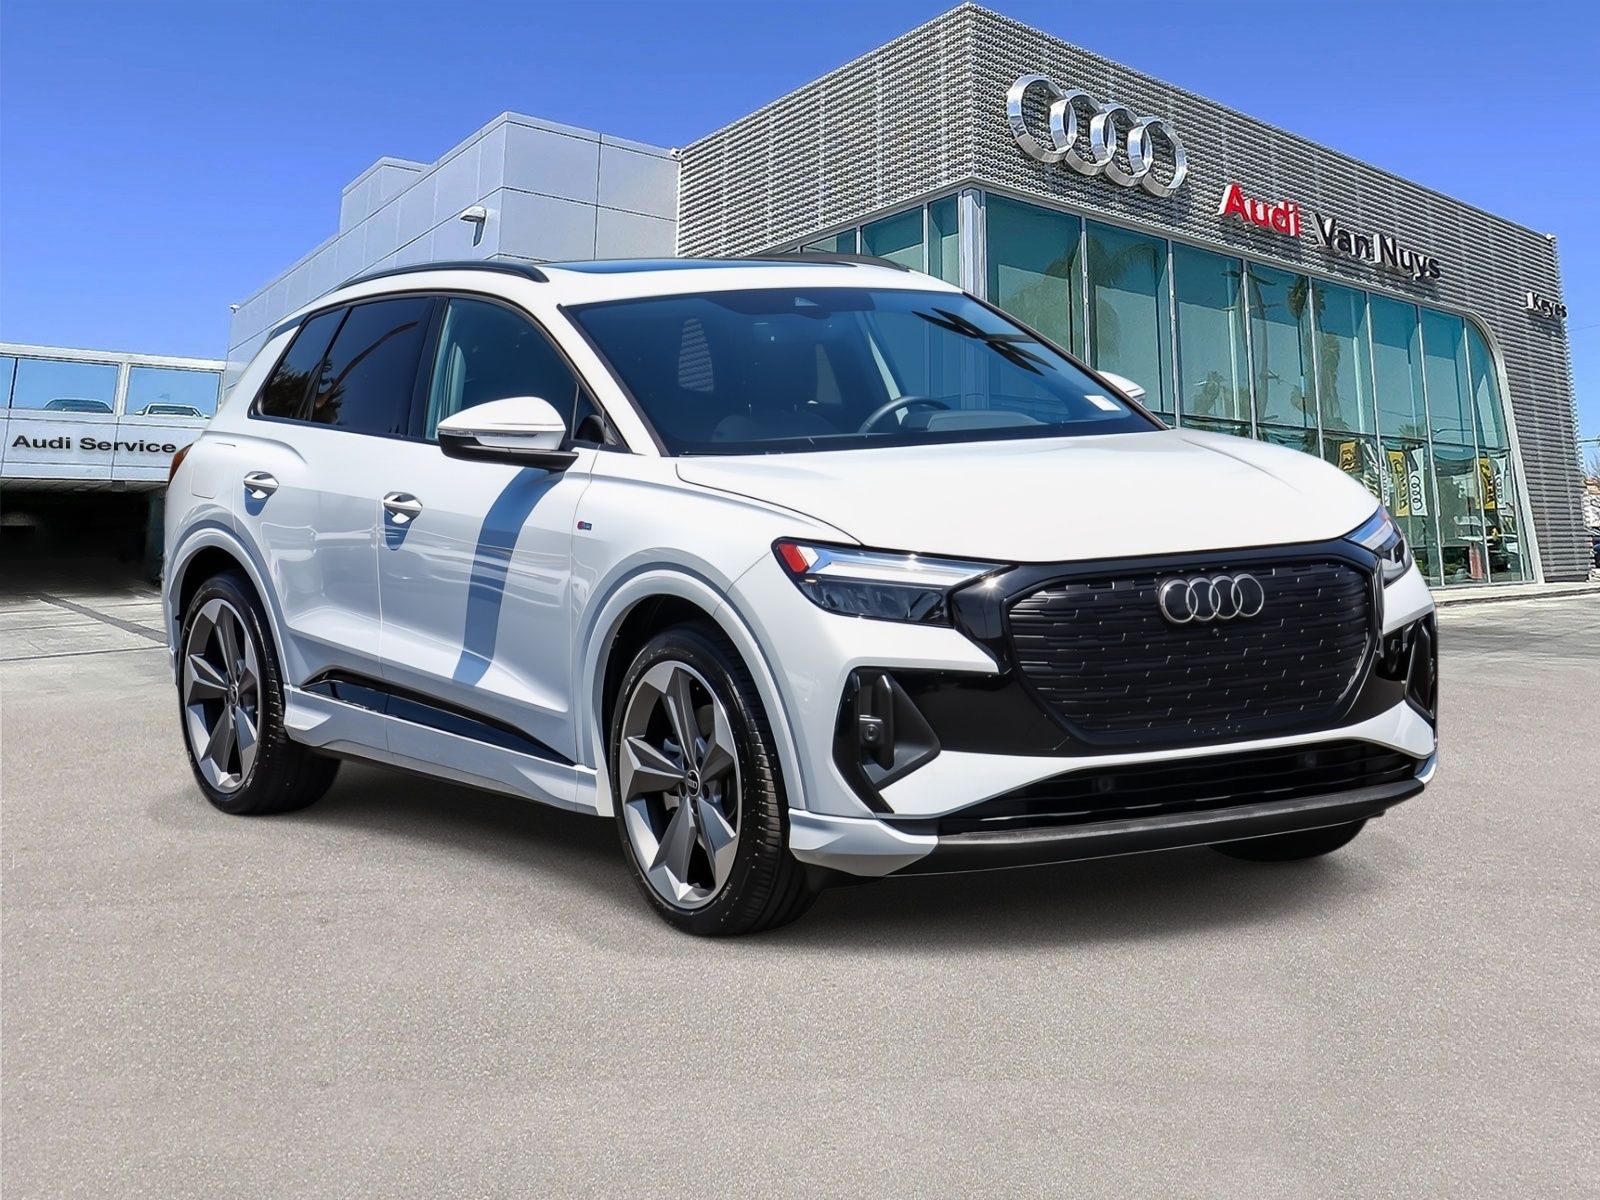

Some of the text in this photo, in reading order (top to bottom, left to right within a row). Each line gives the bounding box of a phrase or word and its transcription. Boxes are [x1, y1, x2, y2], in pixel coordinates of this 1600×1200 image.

[1217, 183, 1441, 280] Audi Van Nuys
[1527, 292, 1568, 318] Keyes
[12, 435, 177, 453] Audi Service
